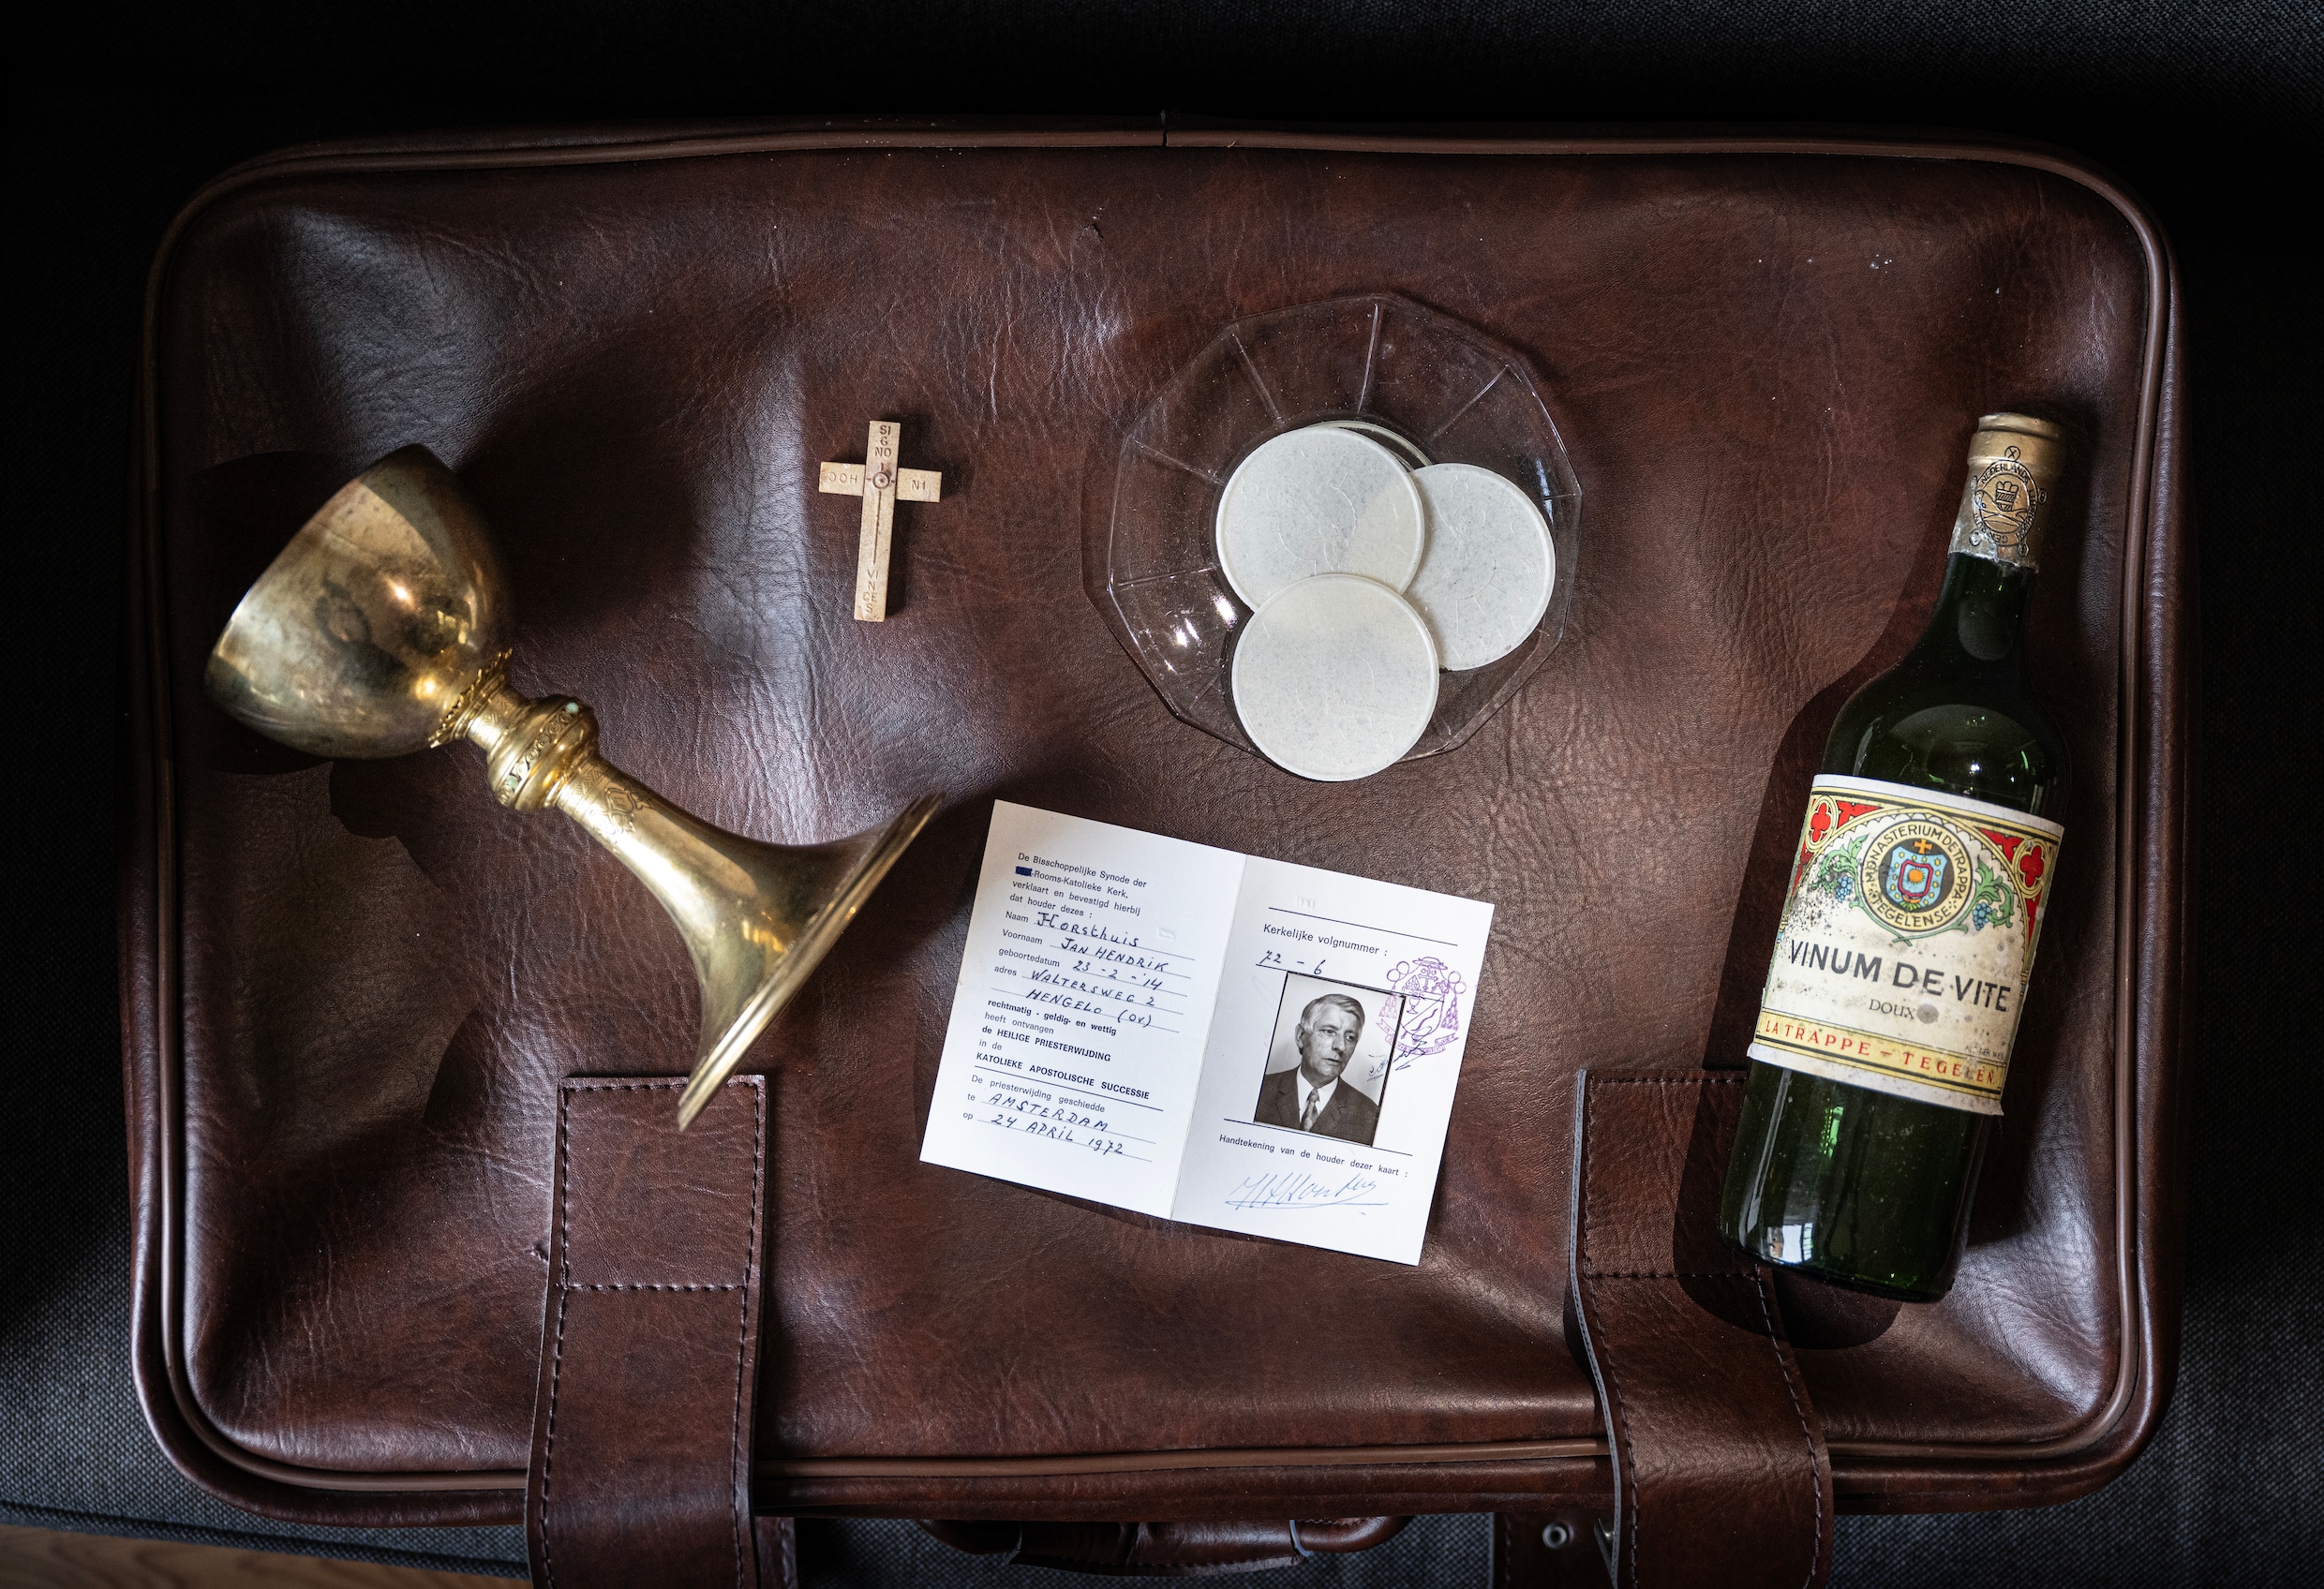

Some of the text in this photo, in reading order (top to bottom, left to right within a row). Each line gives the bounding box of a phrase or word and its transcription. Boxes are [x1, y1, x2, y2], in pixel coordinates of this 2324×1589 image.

[1018, 853, 1147, 888] De Bisschoppelijke Synode der
[1866, 824, 1968, 899] MONASTERIUM DE TRAPPA
[1009, 893, 1023, 903] dat
[1027, 897, 1056, 911] houder
[1012, 881, 1049, 895] verklaart
[1069, 891, 1110, 908] bevestigd
[1113, 901, 1140, 916] hierbij
[1870, 897, 1952, 927] TEGELENSE
[1005, 911, 1029, 923] Naam
[1263, 923, 1314, 942] Kerkelijke
[1002, 928, 1043, 944] Voornaam
[1061, 937, 1089, 954] JAN
[998, 948, 1060, 967] geboortedatum
[1072, 959, 1090, 972] 23
[1791, 939, 2011, 1012] VINUM DE VITE
[994, 965, 1155, 1006] adres WALTERSWEG 2
[1026, 988, 1102, 1015] HENGELO
[984, 1012, 1054, 1034] heeft ontvangen
[988, 1000, 1032, 1017] rechtmatig
[1091, 1023, 1117, 1036] wettig
[1869, 999, 1915, 1019] DOUX
[991, 1042, 1003, 1050] de
[997, 1029, 1031, 1043] HEILIGE
[1035, 1037, 1111, 1062] PRIESTERWIJDING
[976, 1052, 1150, 1100] KATOLIEKE APOSTOLISCHE SUCCESSIE
[971, 1075, 1106, 1112] De priesterwijding geschiedde
[989, 1092, 1109, 1131] AMSTERDAM
[962, 1112, 974, 1121] op
[991, 1114, 1018, 1128] 24
[1088, 1138, 1123, 1155] 1972
[1219, 1134, 1275, 1152] Handtekening
[1280, 1147, 1295, 1155] van
[1300, 1150, 1311, 1158] de
[1316, 1152, 1345, 1166] houder
[1349, 1159, 1373, 1171] dezer
[1378, 1165, 1399, 1176] kaart
